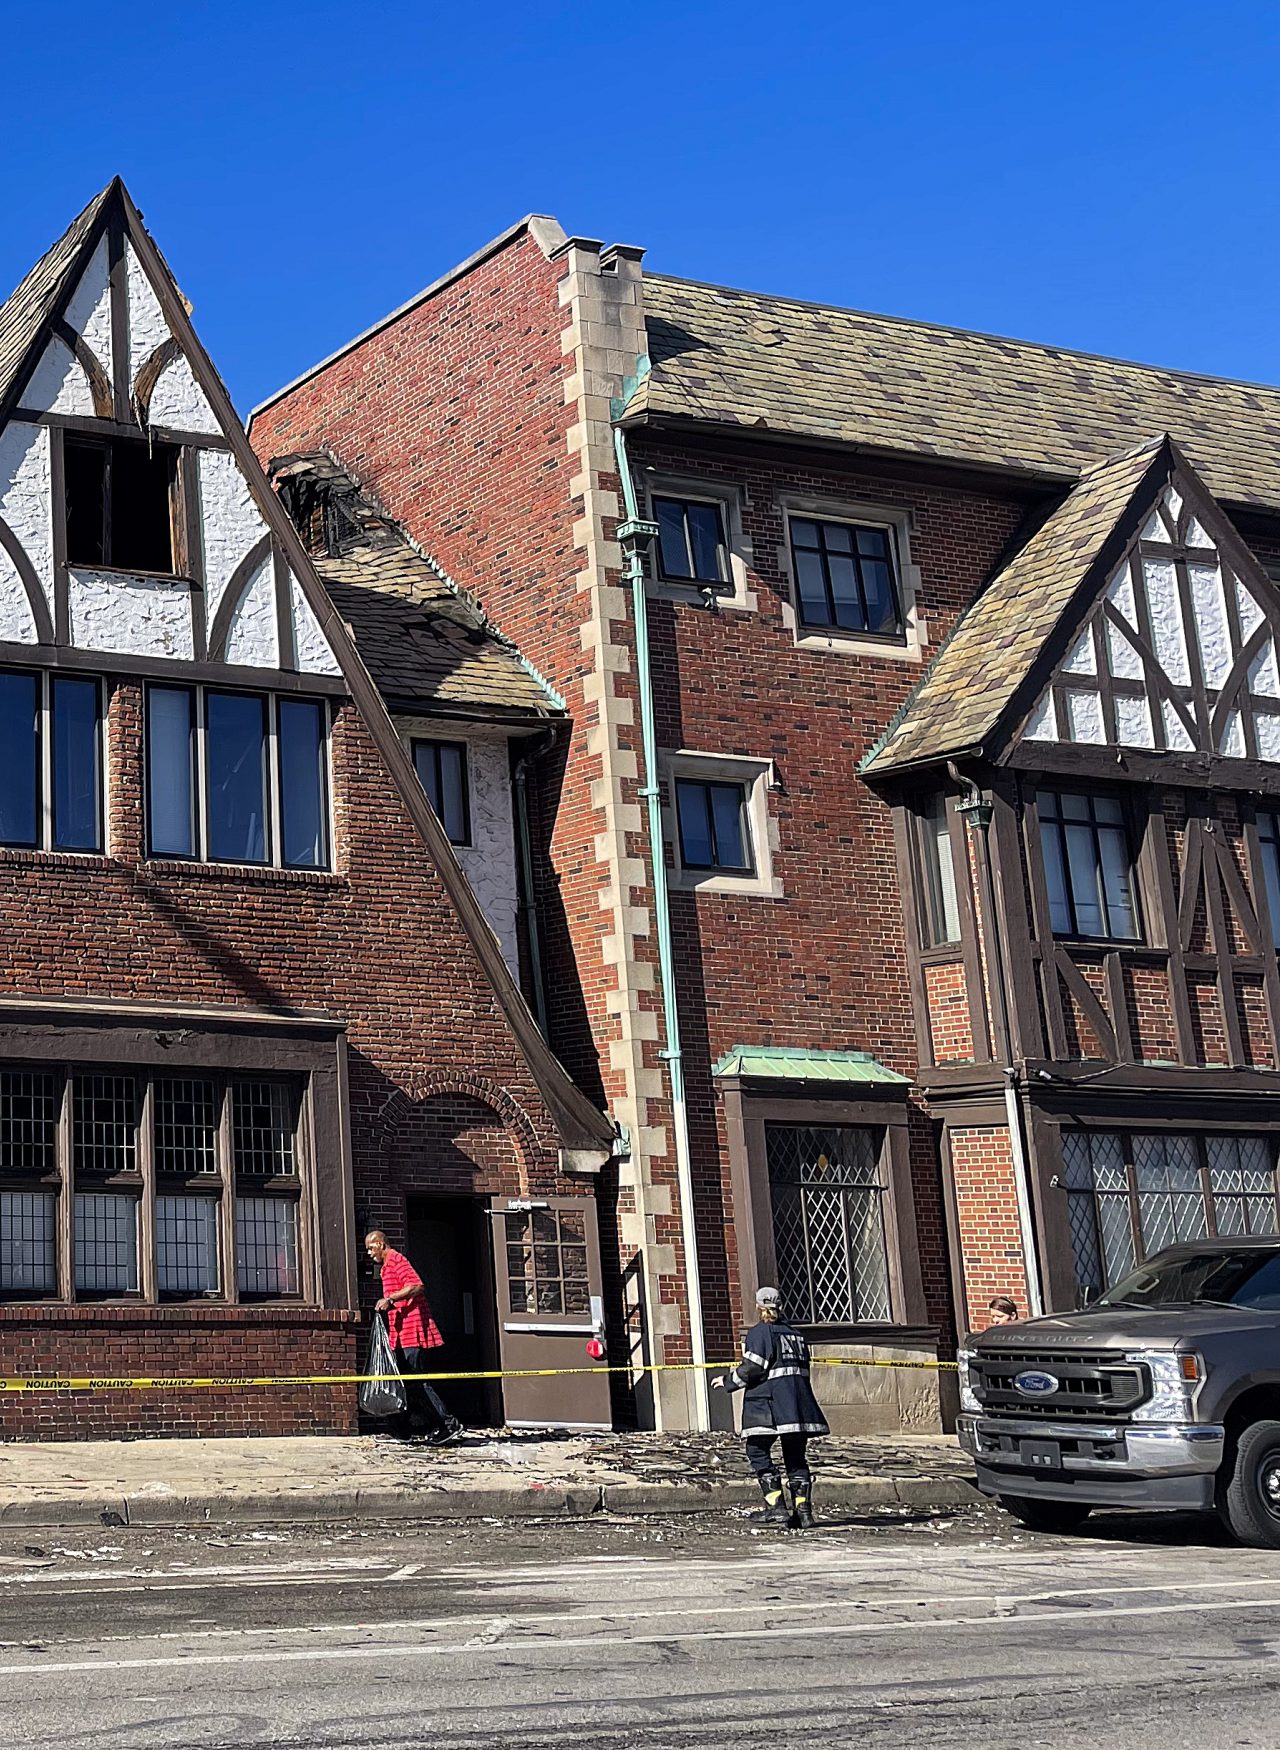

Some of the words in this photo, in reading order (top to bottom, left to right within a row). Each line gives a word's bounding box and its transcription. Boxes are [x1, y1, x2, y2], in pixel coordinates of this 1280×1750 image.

[780, 1334, 805, 1355] ATF
[26, 1380, 71, 1388] CAUTION
[89, 1380, 133, 1388] CAUTION
[151, 1379, 194, 1387] CAUTION
[1024, 1377, 1046, 1390] Ford
